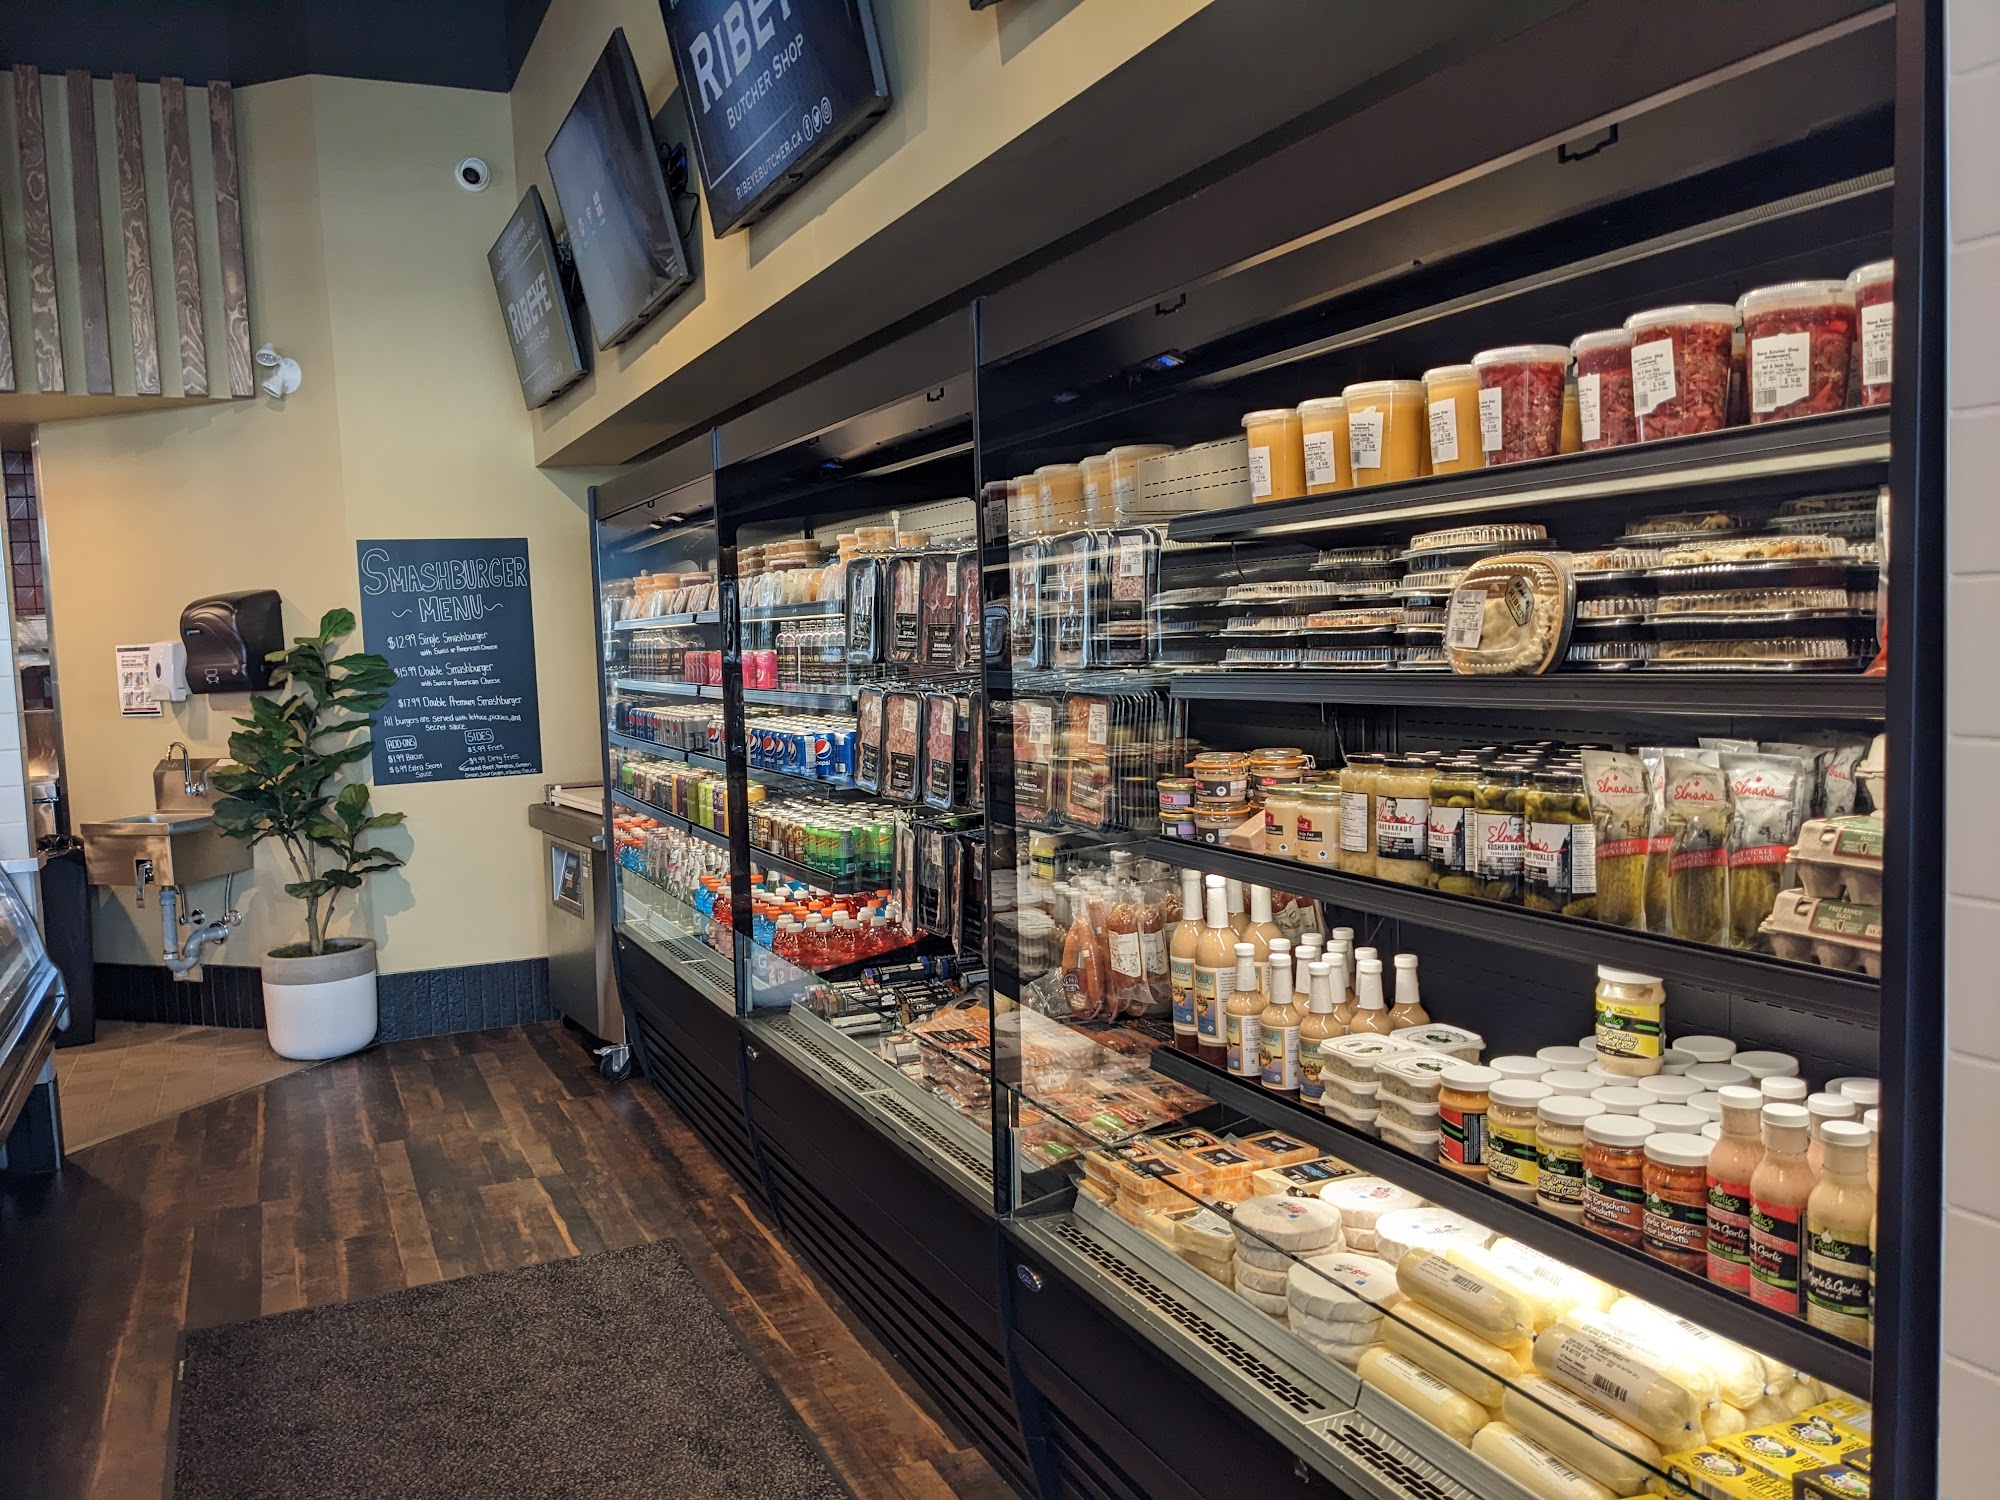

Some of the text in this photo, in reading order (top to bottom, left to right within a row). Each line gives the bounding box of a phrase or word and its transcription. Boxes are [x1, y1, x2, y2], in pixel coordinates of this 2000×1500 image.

[689, 0, 791, 114] RIBE
[726, 33, 804, 130] BUTCHER SHOP
[736, 130, 803, 200] RIBEYEBUTCHER.CA
[507, 270, 553, 344] RIBEYE
[361, 548, 528, 595] SMASHBURGER
[418, 594, 485, 623] MENU
[387, 632, 488, 650] $12.99 Single Smashburger
[394, 662, 493, 678] $15.99 Double Smashburger
[453, 678, 479, 686] American
[398, 695, 522, 708] $17.99 Double Premium Smashburger
[383, 716, 393, 727] All
[395, 715, 419, 727] burgers
[420, 715, 430, 723] are
[467, 731, 492, 743] SIDES
[405, 753, 424, 761] Bacon
[467, 745, 485, 753] $3.99
[408, 763, 424, 772] Extra
[469, 755, 486, 765] $9.99
[487, 755, 502, 764] Dirty
[1597, 776, 1643, 794] Elman's
[1674, 782, 1724, 801] Elman's
[1734, 778, 1788, 798] Elman's
[1487, 843, 1508, 852] KOSHER
[1745, 848, 1773, 856] PICKLE
[1532, 852, 1554, 862] PICKLES
[1843, 907, 1863, 916] RANGE
[1592, 1194, 1630, 1214] Bruschetta
[1709, 1188, 1739, 1209] Garlic's
[1661, 1220, 1701, 1238] Bruschetta
[1721, 1224, 1748, 1240] Garlic
[1757, 1244, 1782, 1263] Garlic
[1813, 1235, 1850, 1257] Garlic's
[1833, 1279, 1862, 1297] Garlic
